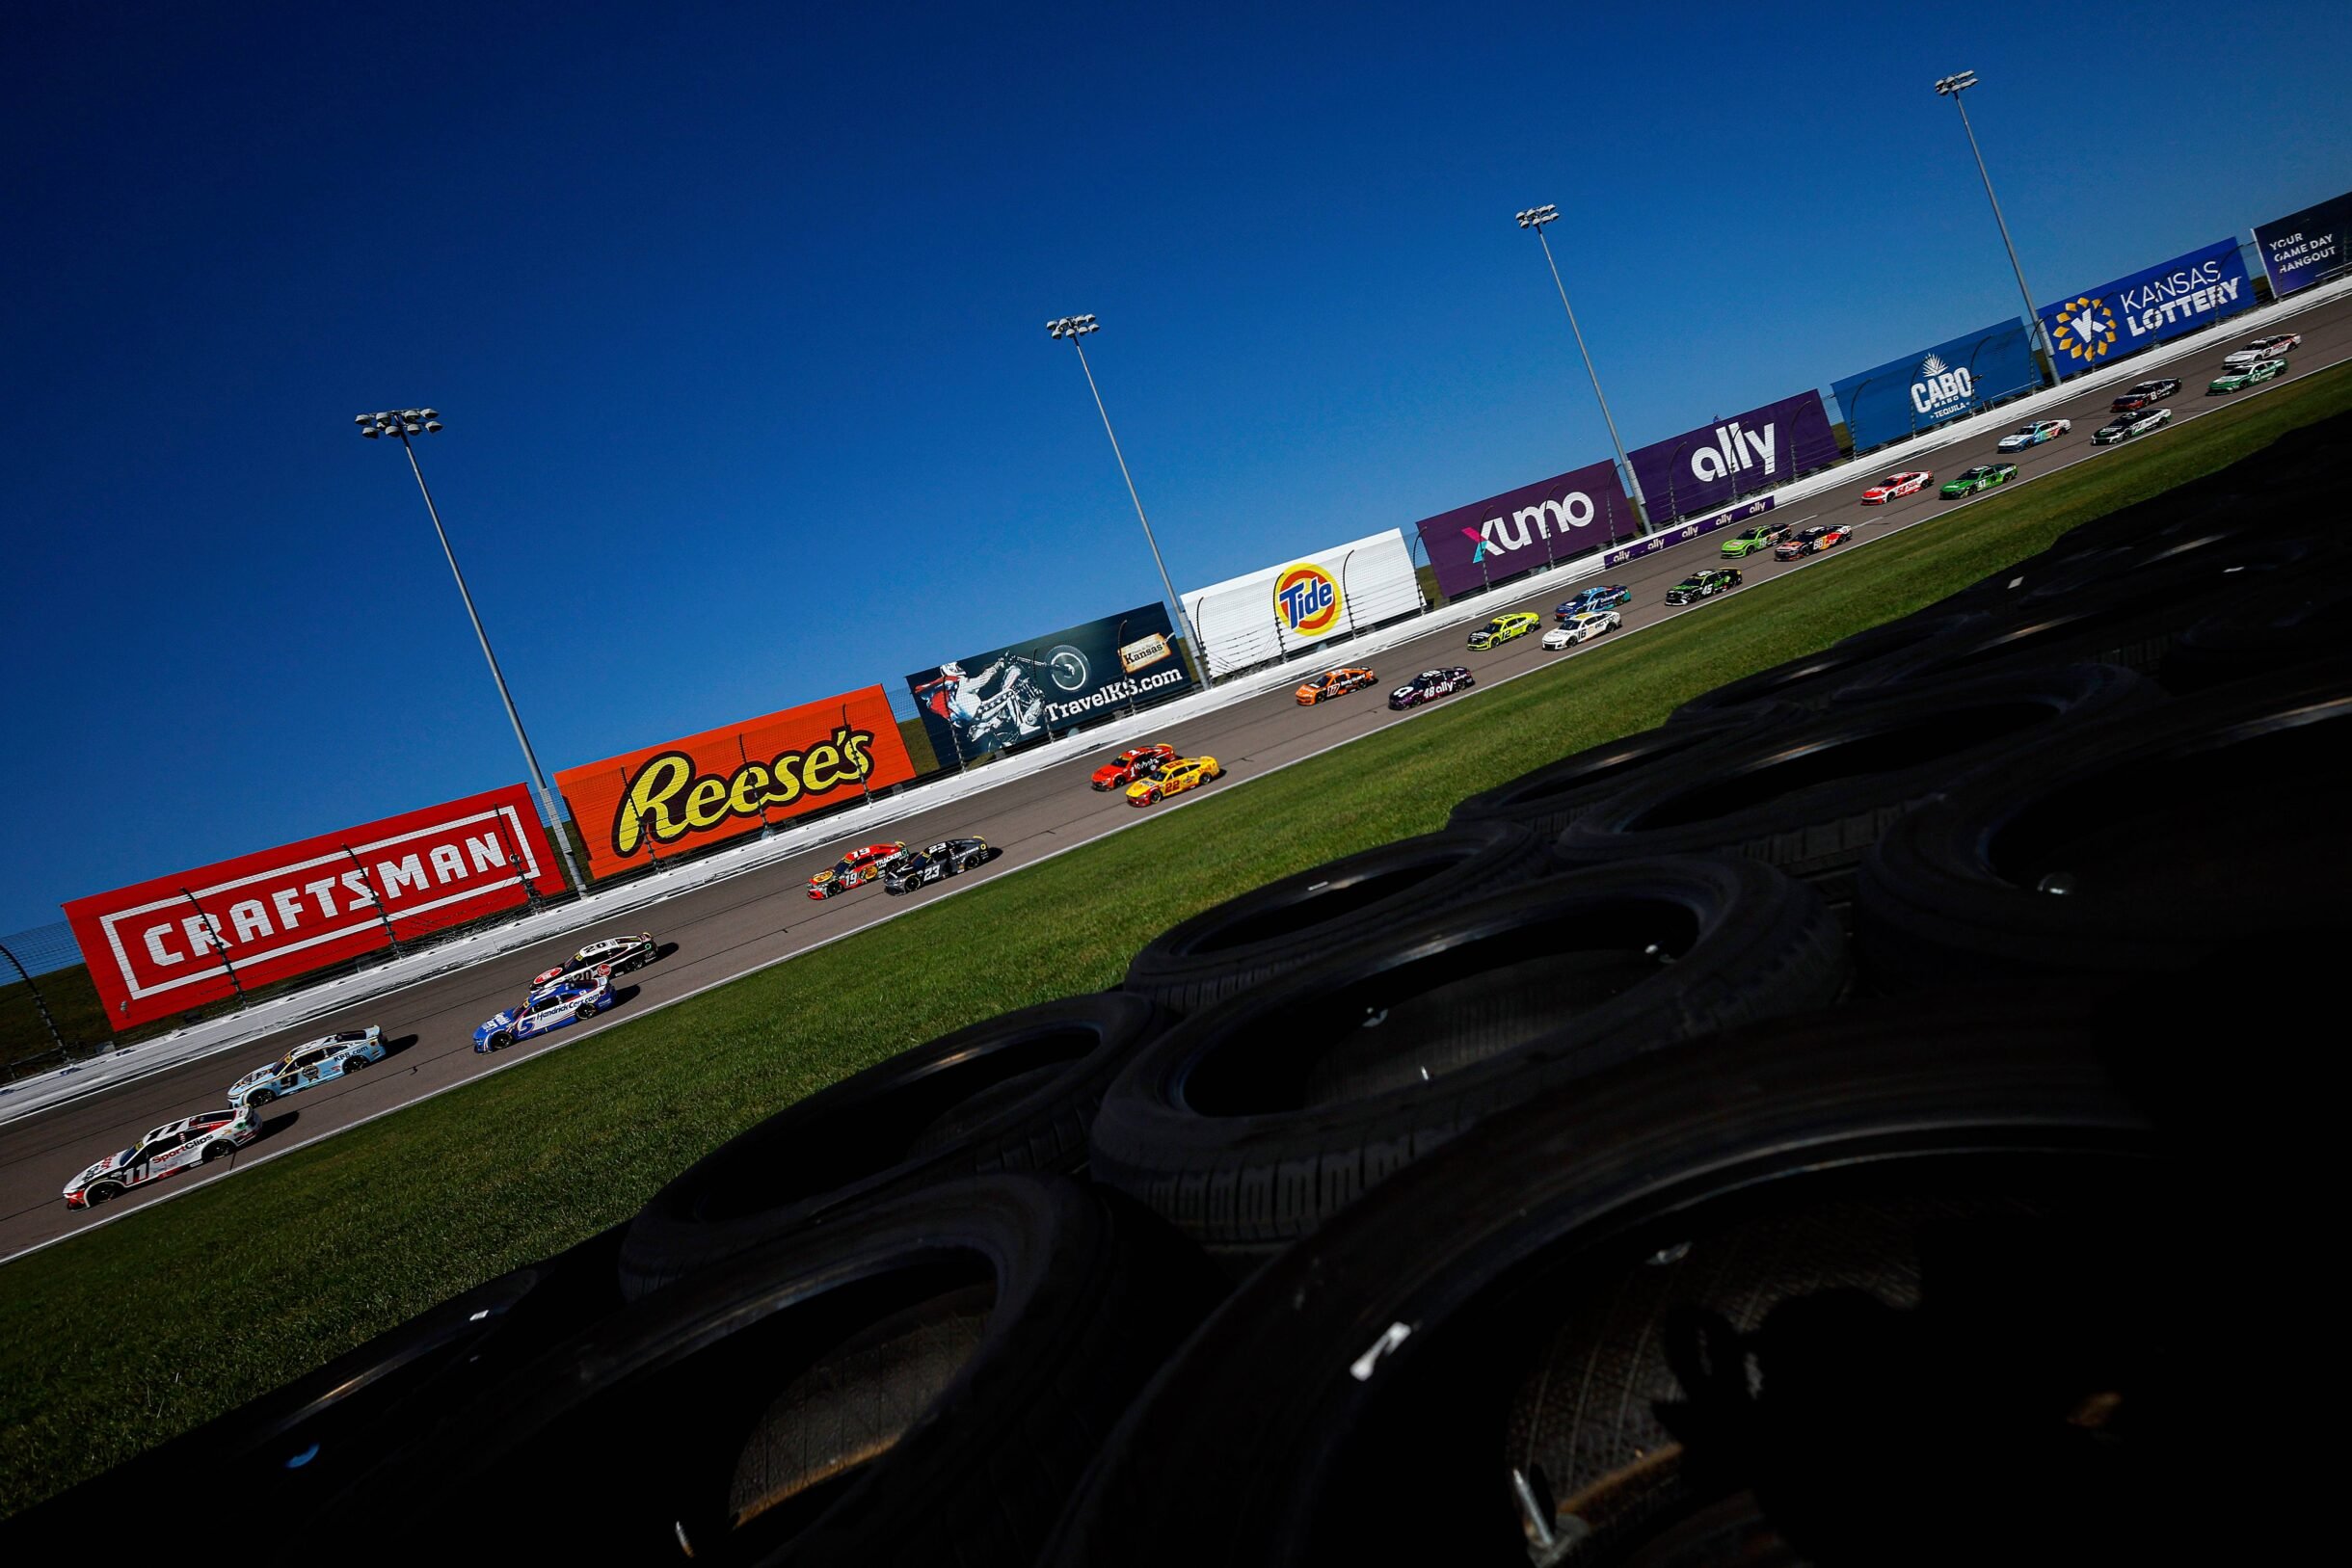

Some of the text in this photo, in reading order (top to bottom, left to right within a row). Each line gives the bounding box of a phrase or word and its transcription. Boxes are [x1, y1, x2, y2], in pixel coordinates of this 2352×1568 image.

[2269, 232, 2303, 251] YOUR
[2274, 233, 2334, 262] GAME DAY
[2279, 246, 2336, 274] HANGOUT
[2120, 260, 2221, 314] KANSAS
[2126, 277, 2239, 337] LOTTERY
[1911, 366, 1972, 413] CABO
[2150, 390, 2158, 401] 8
[1934, 395, 1960, 409] WABO
[1934, 402, 1966, 418] TEQUILA
[1691, 421, 1776, 483] ally
[1749, 500, 1766, 515] ally
[1716, 513, 1733, 526] ally
[1461, 491, 1595, 564] xumo
[1681, 525, 1698, 539] ally
[1647, 537, 1665, 551] ally
[1613, 549, 1630, 564] ally
[1701, 583, 1713, 596] 45
[1279, 577, 1333, 630] Tide
[1586, 598, 1600, 612] 77
[1501, 629, 1511, 640] 12
[1577, 628, 1587, 641] 16
[1122, 643, 1164, 664] Kansas
[1326, 682, 1341, 698] 17
[1423, 686, 1435, 699] 48
[1435, 680, 1454, 694] ally
[1045, 667, 1184, 723] TravelKS.com
[618, 729, 869, 853] Reese's
[1164, 779, 1180, 794] 22
[928, 841, 947, 855] 23
[874, 852, 902, 866] TRACKER
[844, 872, 858, 887] 19
[923, 864, 941, 882] 23
[143, 832, 507, 967] CRAFTSMAN
[582, 942, 606, 953] 20
[518, 1016, 536, 1037] 5
[123, 1162, 148, 1185] 11
